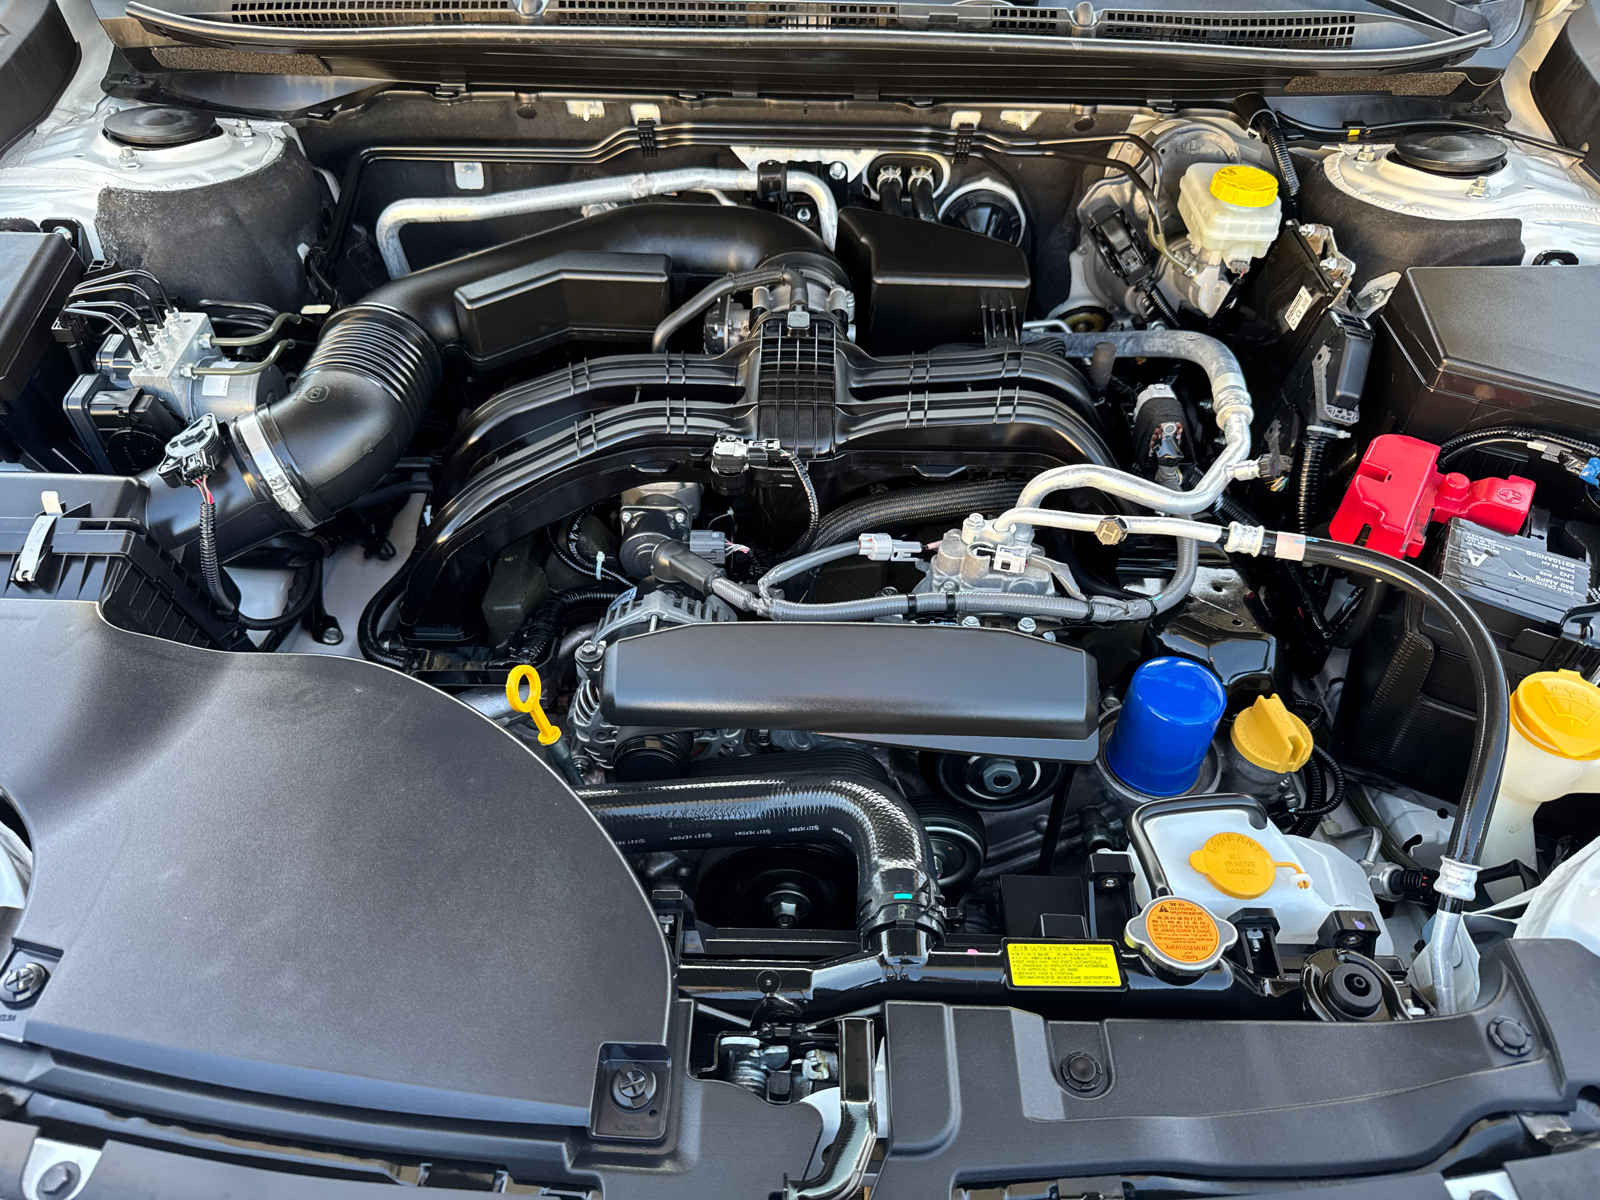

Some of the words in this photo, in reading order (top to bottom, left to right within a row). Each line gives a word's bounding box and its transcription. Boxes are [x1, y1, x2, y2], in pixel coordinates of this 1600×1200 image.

[1559, 571, 1575, 580] LN2
[1525, 577, 1557, 590] CRANKING
[1535, 575, 1559, 586] AMPS
[1553, 576, 1575, 585] GROUP
[1557, 587, 1574, 596] COLD
[1206, 833, 1264, 854] COOLANT
[1226, 867, 1259, 876] MANUAL
